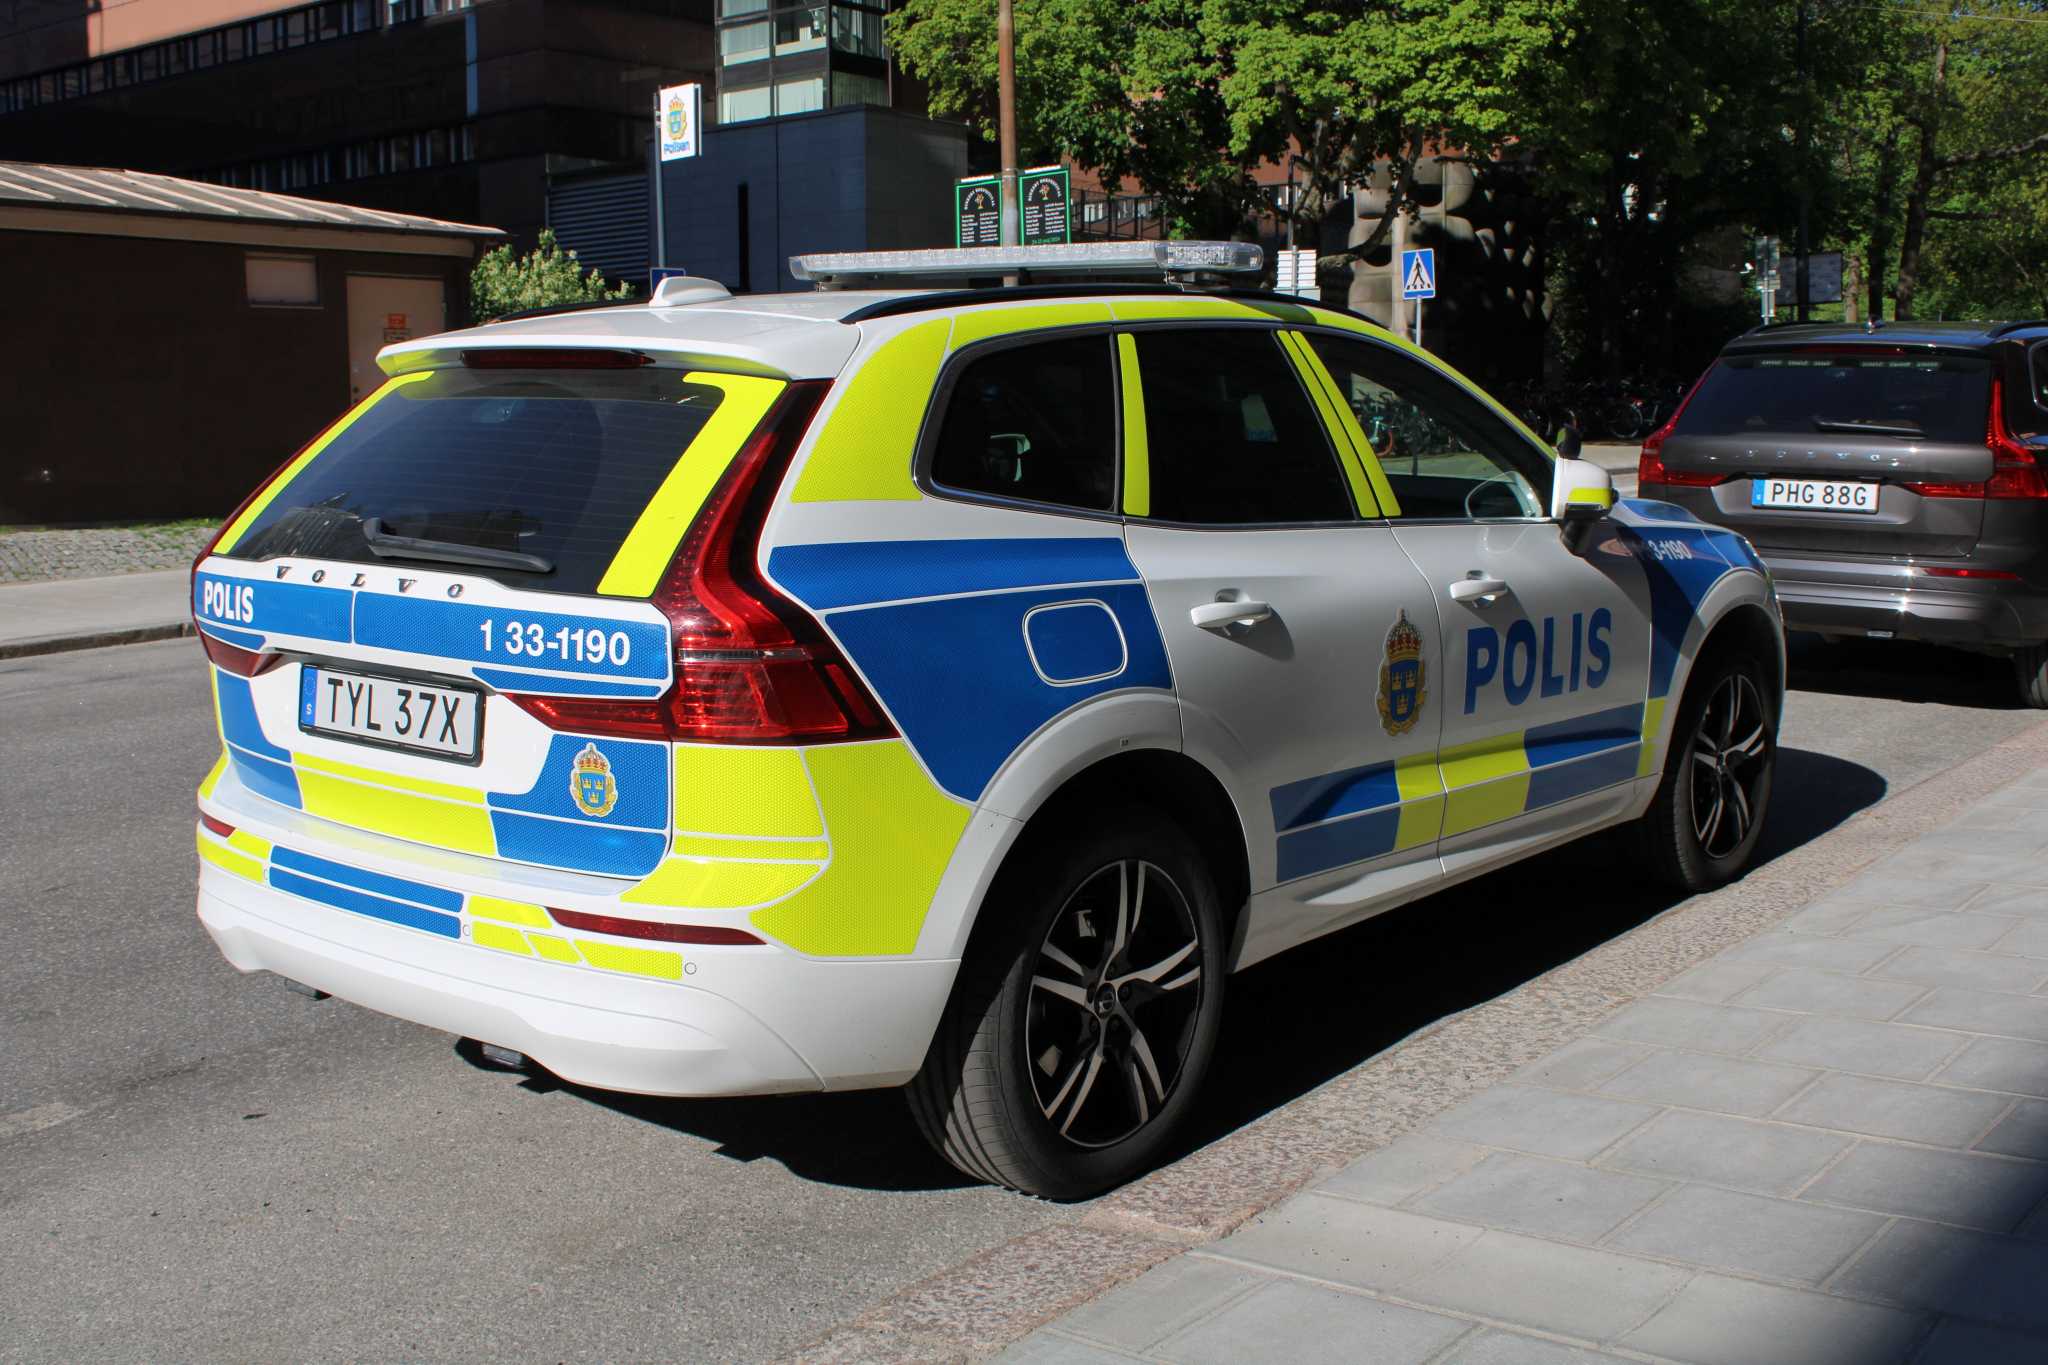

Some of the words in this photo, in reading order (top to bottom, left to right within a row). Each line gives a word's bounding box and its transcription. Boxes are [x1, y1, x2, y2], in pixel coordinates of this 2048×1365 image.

[1771, 482, 1815, 504] PHG
[1822, 484, 1867, 506] 88G
[203, 580, 255, 624] POLIS
[275, 565, 464, 598] VOLVO
[480, 619, 493, 651] 1
[505, 621, 631, 666] 33-1190
[1464, 607, 1612, 715] POLIS
[305, 703, 312, 716] S
[327, 677, 382, 731] TYL
[395, 688, 461, 745] 37X
